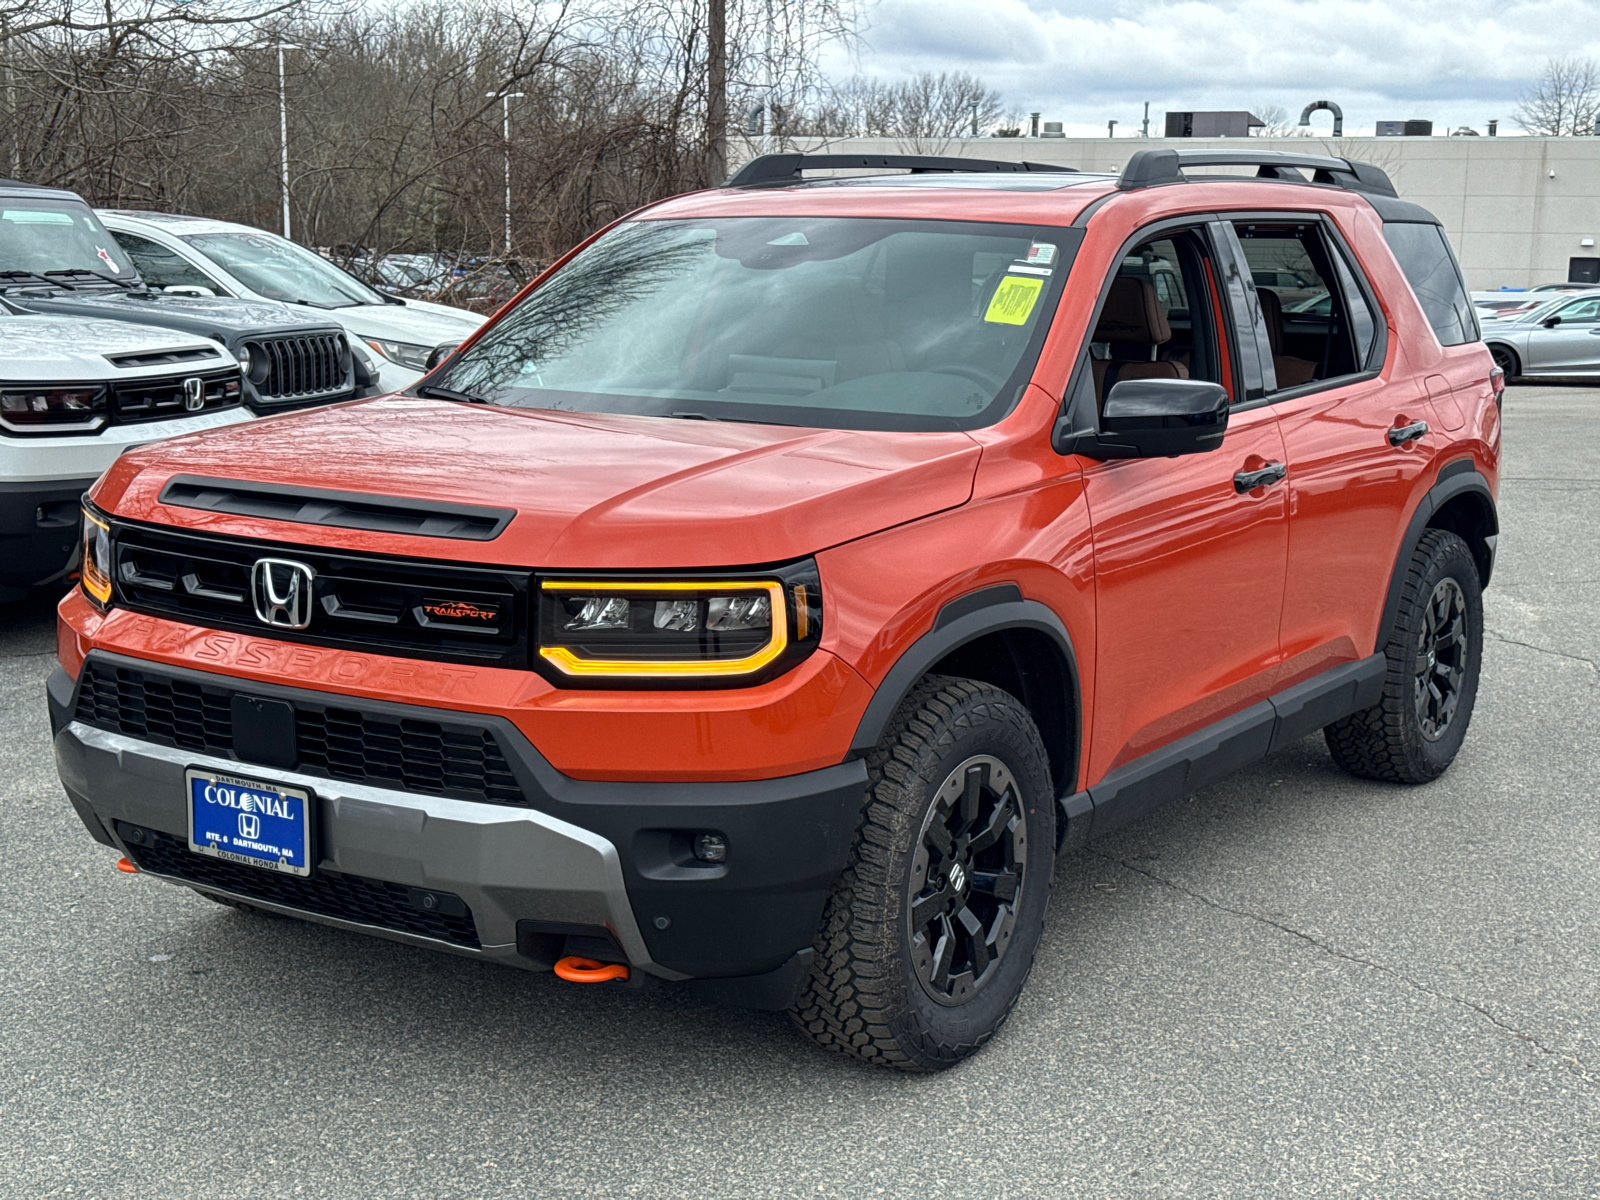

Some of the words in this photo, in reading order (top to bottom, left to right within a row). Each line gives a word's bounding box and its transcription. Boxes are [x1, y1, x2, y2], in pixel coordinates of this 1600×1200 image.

[424, 605, 496, 620] TRAILSPORT
[129, 618, 478, 694] PASSPORT
[265, 784, 278, 792] MA
[204, 785, 294, 820] COLONIAL
[206, 831, 222, 842] RTE.
[233, 838, 281, 856] DARTMOUTH,
[282, 849, 294, 858] MA
[217, 850, 251, 864] COLONIAL
[253, 858, 279, 870] HONDA
